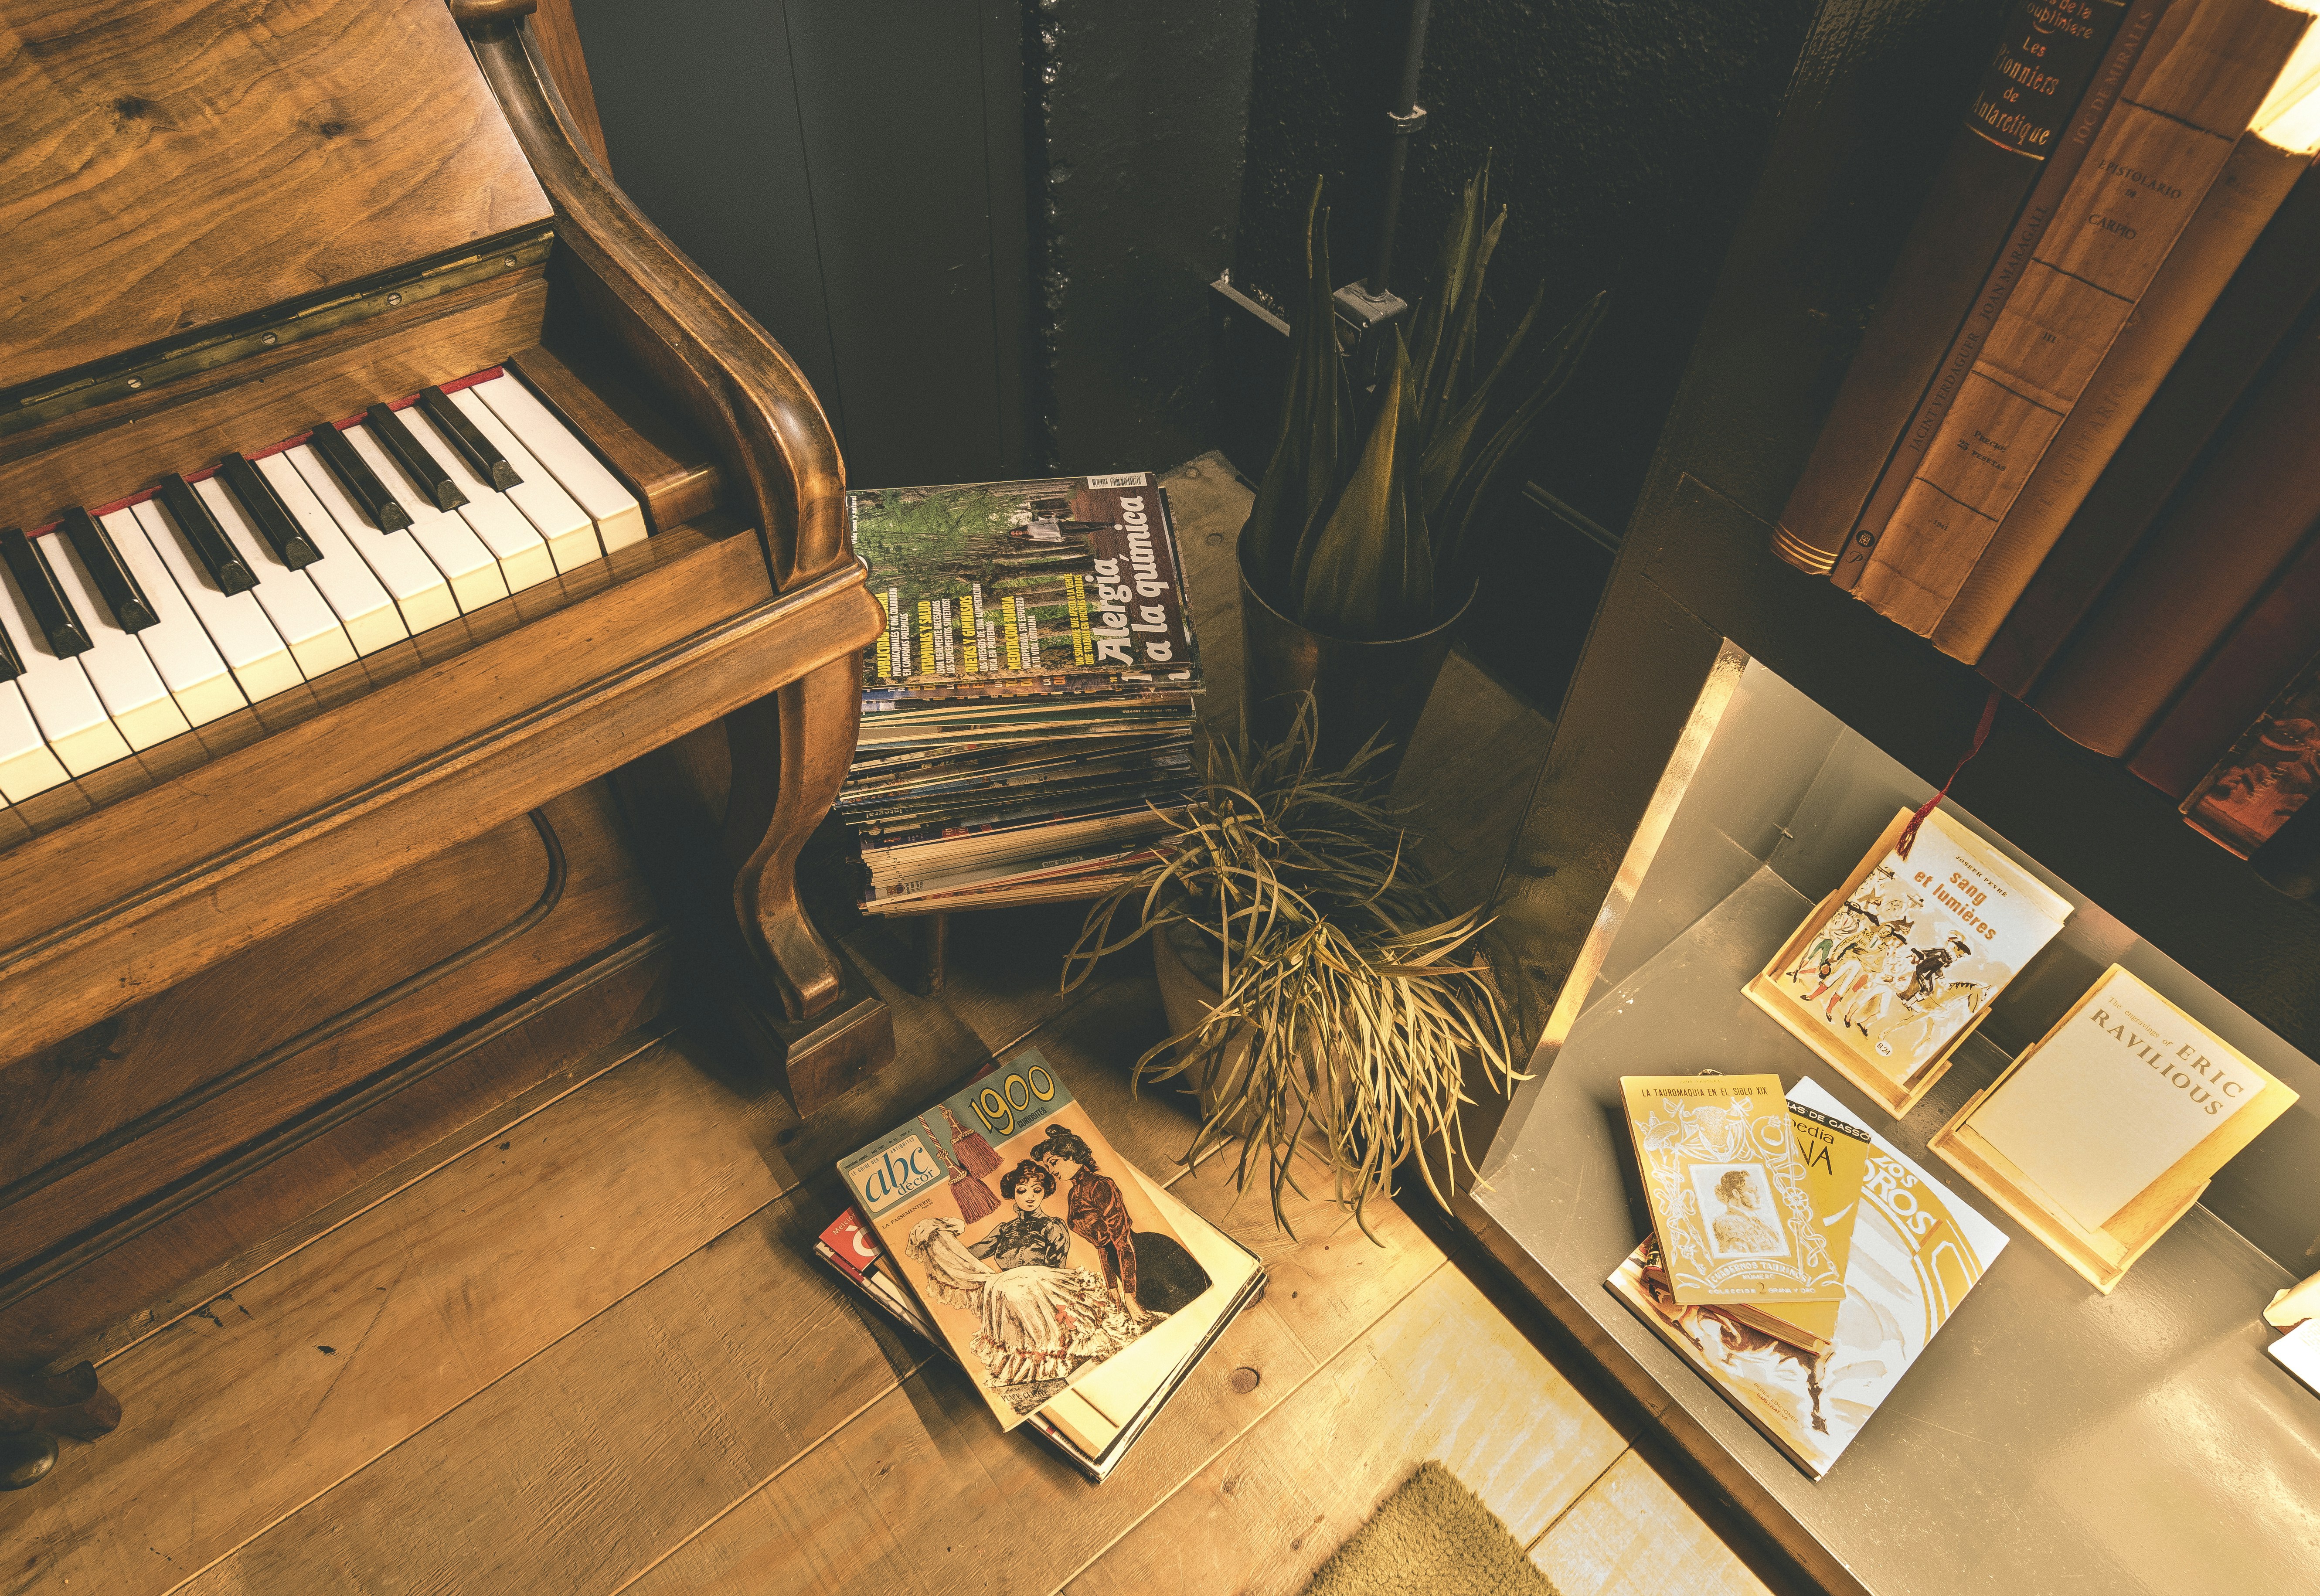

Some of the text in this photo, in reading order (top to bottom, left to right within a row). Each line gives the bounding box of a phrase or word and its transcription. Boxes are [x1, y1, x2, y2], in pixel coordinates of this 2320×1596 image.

[2022, 35, 2047, 58] Les
[1993, 42, 2060, 95] Pionniers
[2003, 87, 2020, 102] de
[2098, 160, 2182, 199] EPISTOLARIO
[2089, 214, 2136, 240] CARPIO
[1999, 205, 2049, 284] MARAGALL
[1932, 333, 1980, 408] VERDAGUER
[1957, 439, 1970, 451] 25
[1114, 496, 1170, 597] química
[1064, 573, 1074, 588] GENTE
[1074, 575, 1085, 599] CERRADAS
[889, 588, 898, 615] COLABORAN
[918, 601, 932, 624] SALUD
[932, 600, 942, 629] NECESARIOS
[1001, 596, 1016, 622] DIARIA
[1016, 597, 1026, 622] ESFUERZO
[1068, 600, 1078, 616] AFECTA
[1078, 600, 1088, 621] OFICINAS
[1085, 558, 1133, 667] Alergia
[890, 615, 899, 626] ONG
[959, 596, 975, 637] GIMNASIOS
[976, 619, 985, 630] UNA
[1018, 623, 1027, 632] SIN
[1027, 615, 1038, 641] COTIDIANA
[1070, 617, 1079, 628] QUE
[1131, 604, 1168, 632] la
[891, 631, 901, 677] MULTINACIONALES
[901, 640, 911, 667] CAMPAÑAS
[919, 632, 935, 675] VITAMINAS
[934, 630, 945, 660] REALMENTE
[944, 627, 954, 662] SUPLEMENTOS
[977, 639, 987, 661] RIESGOS
[988, 648, 997, 657] EN
[1002, 623, 1021, 670] MEDITACIÓN
[1030, 642, 1040, 656] VIDA
[1082, 630, 1092, 653] TRABAJA
[1146, 640, 1172, 661] a
[946, 662, 955, 674] LOS
[963, 645, 978, 672] DIETAS
[979, 661, 988, 671] LOS
[989, 658, 998, 671] RICA
[1075, 657, 1084, 665] UN
[1084, 653, 1094, 665] QUE
[866, 808, 902, 819] integral
[1949, 872, 1987, 906] sang
[1956, 856, 2007, 897] JOSEPH PEYRÉ
[1914, 871, 1997, 940] et lumières
[2109, 997, 2122, 1009] The
[2125, 1011, 2160, 1038] engravings
[2175, 1043, 2244, 1098] ERIC
[2089, 1007, 2223, 1115] RAVILIOUS
[968, 1065, 1055, 1136] 1900
[1653, 1088, 1705, 1098] TAUROMAQUIA
[1721, 1088, 1730, 1096] EL
[1733, 1087, 1753, 1096] SIGLO
[1756, 1087, 1768, 1095] XIX
[1809, 1111, 1824, 1122] DE
[857, 1163, 871, 1173] GUIDE
[865, 1147, 929, 1203] abc
[1869, 1155, 1919, 1188] LOS
[891, 1197, 932, 1225] PASSEMENTERIE
[1711, 1262, 1807, 1283] CUADERNOS TAURINOS
[1756, 1282, 1766, 1294] 2
[1001, 1393, 1022, 1402] PLACE
[1754, 1382, 1798, 1424] PEREA EDICIONES
[1757, 1392, 1788, 1421] ILUSTRATIVA
